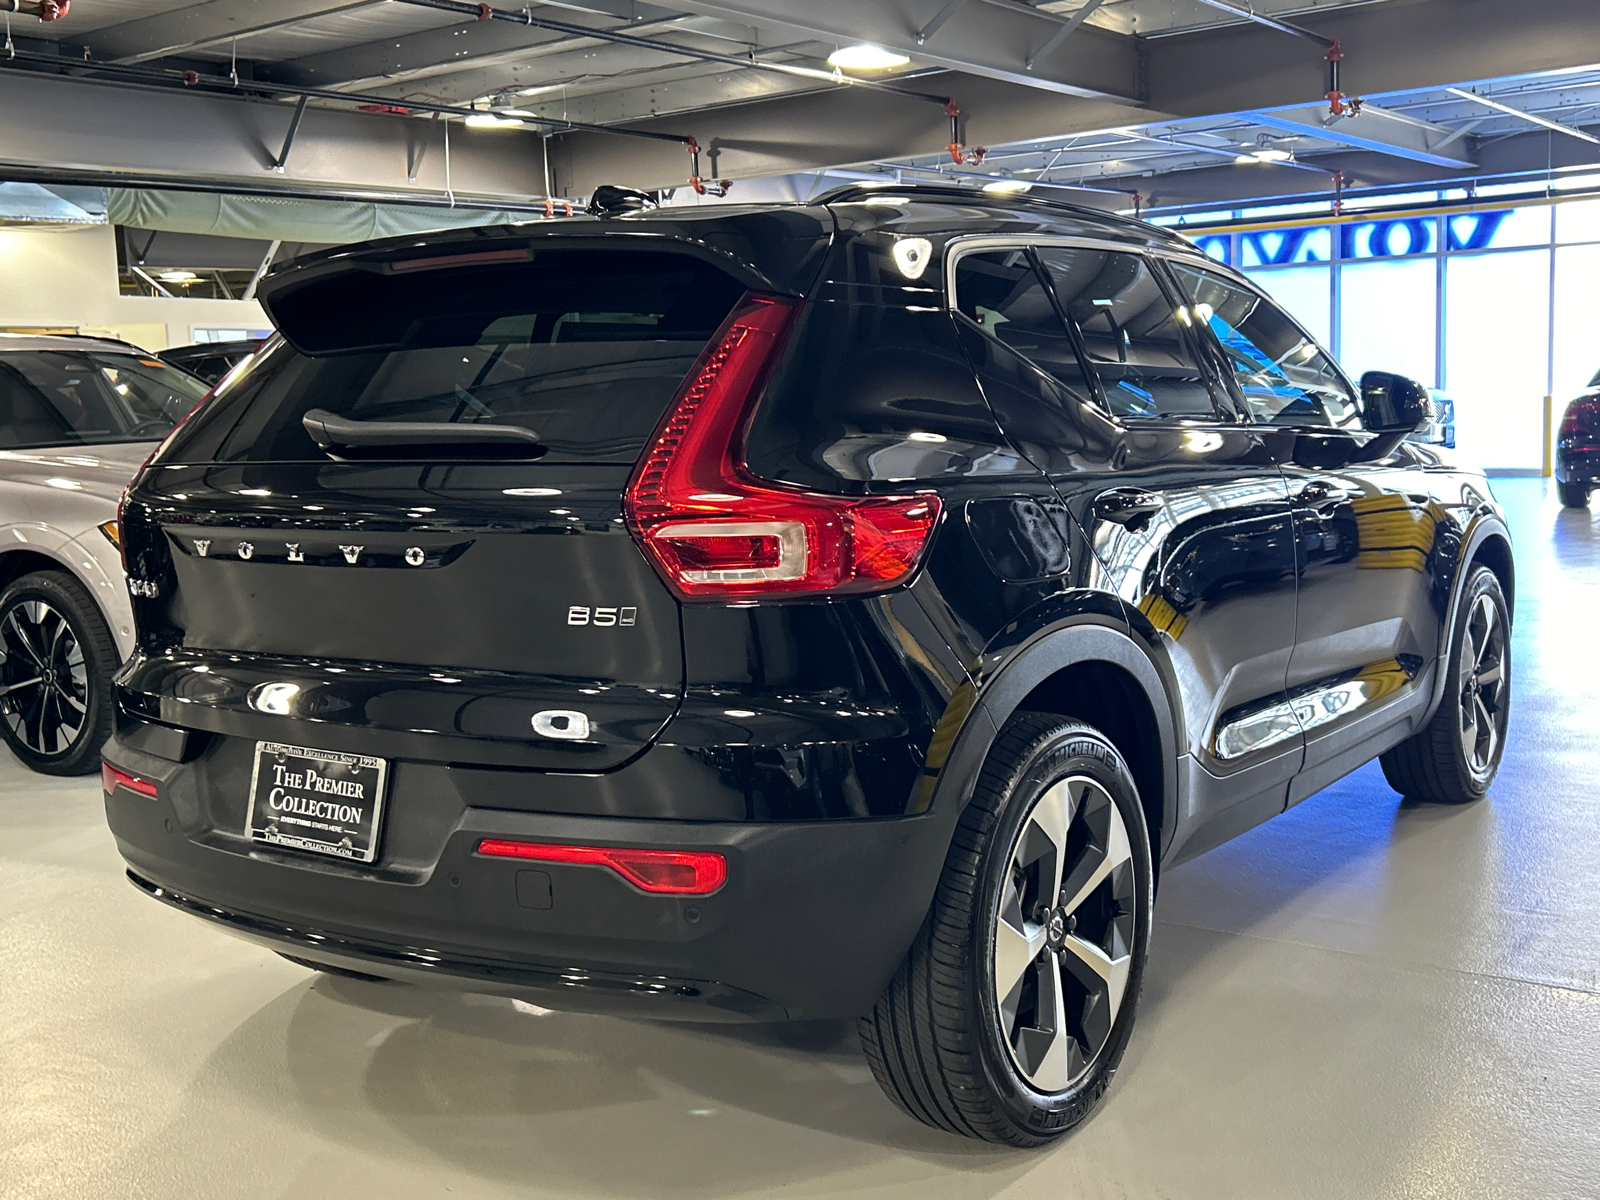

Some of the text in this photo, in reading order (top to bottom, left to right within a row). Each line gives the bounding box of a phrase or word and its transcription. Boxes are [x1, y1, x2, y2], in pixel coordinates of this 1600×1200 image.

[193, 538, 426, 567] VOLVO
[567, 605, 618, 627] B5
[303, 749, 339, 761] EXCELLENCE
[359, 757, 377, 767] 1995
[1054, 742, 1106, 768] MICHELIN
[272, 764, 365, 800] THE PREMIER
[268, 787, 363, 825] COLLECTION
[280, 815, 312, 828] EVERYTHING
[311, 821, 329, 831] STARTS
